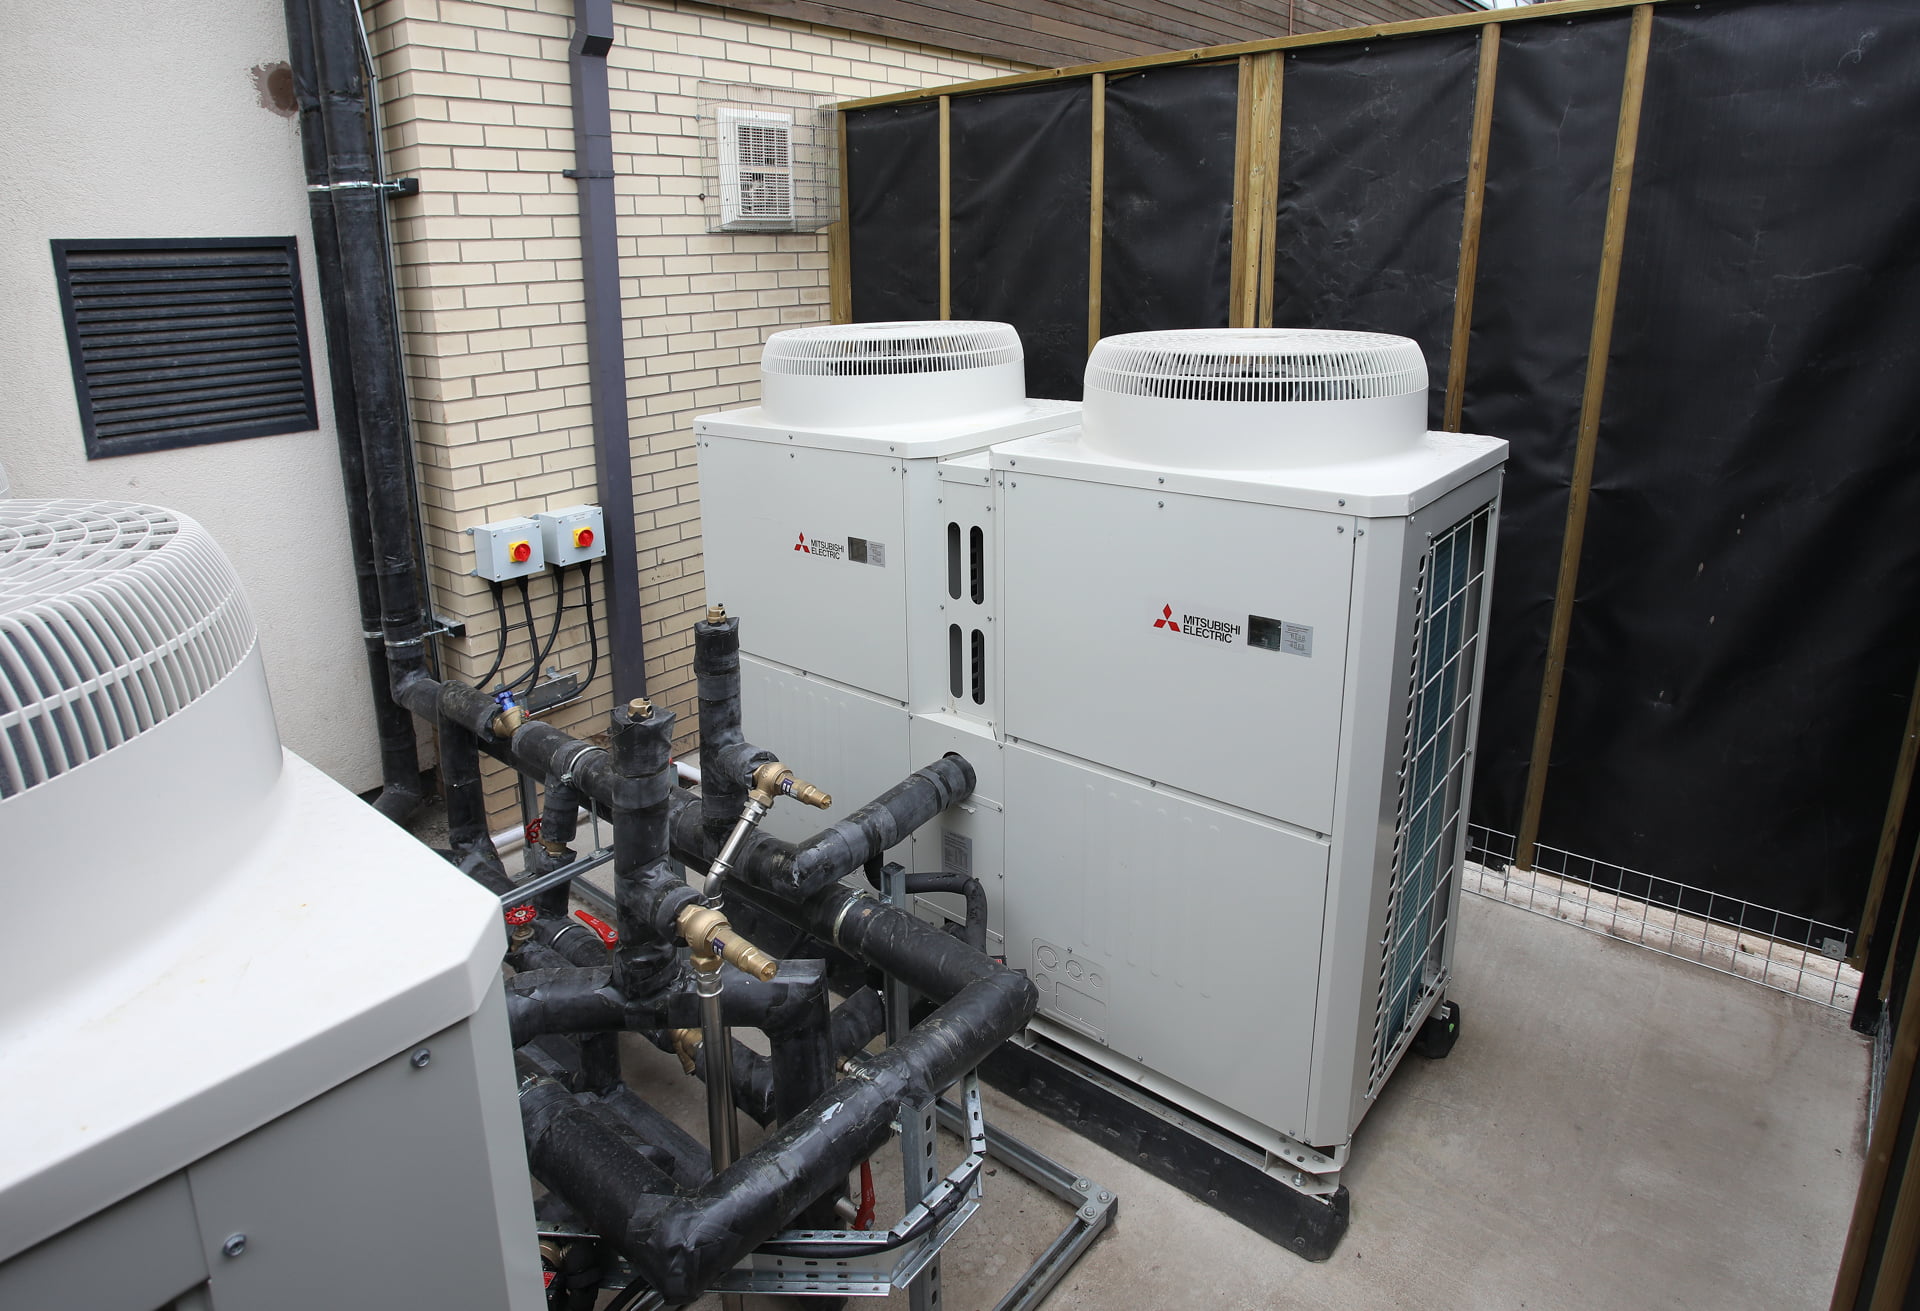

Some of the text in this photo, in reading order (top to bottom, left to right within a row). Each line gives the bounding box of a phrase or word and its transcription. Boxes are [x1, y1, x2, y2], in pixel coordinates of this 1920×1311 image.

[810, 538, 845, 553] MITSUBISHI
[811, 546, 841, 560] ELECTRIC
[1183, 614, 1241, 635] MITSUBISHI
[1183, 624, 1233, 644] ELECTRIC
